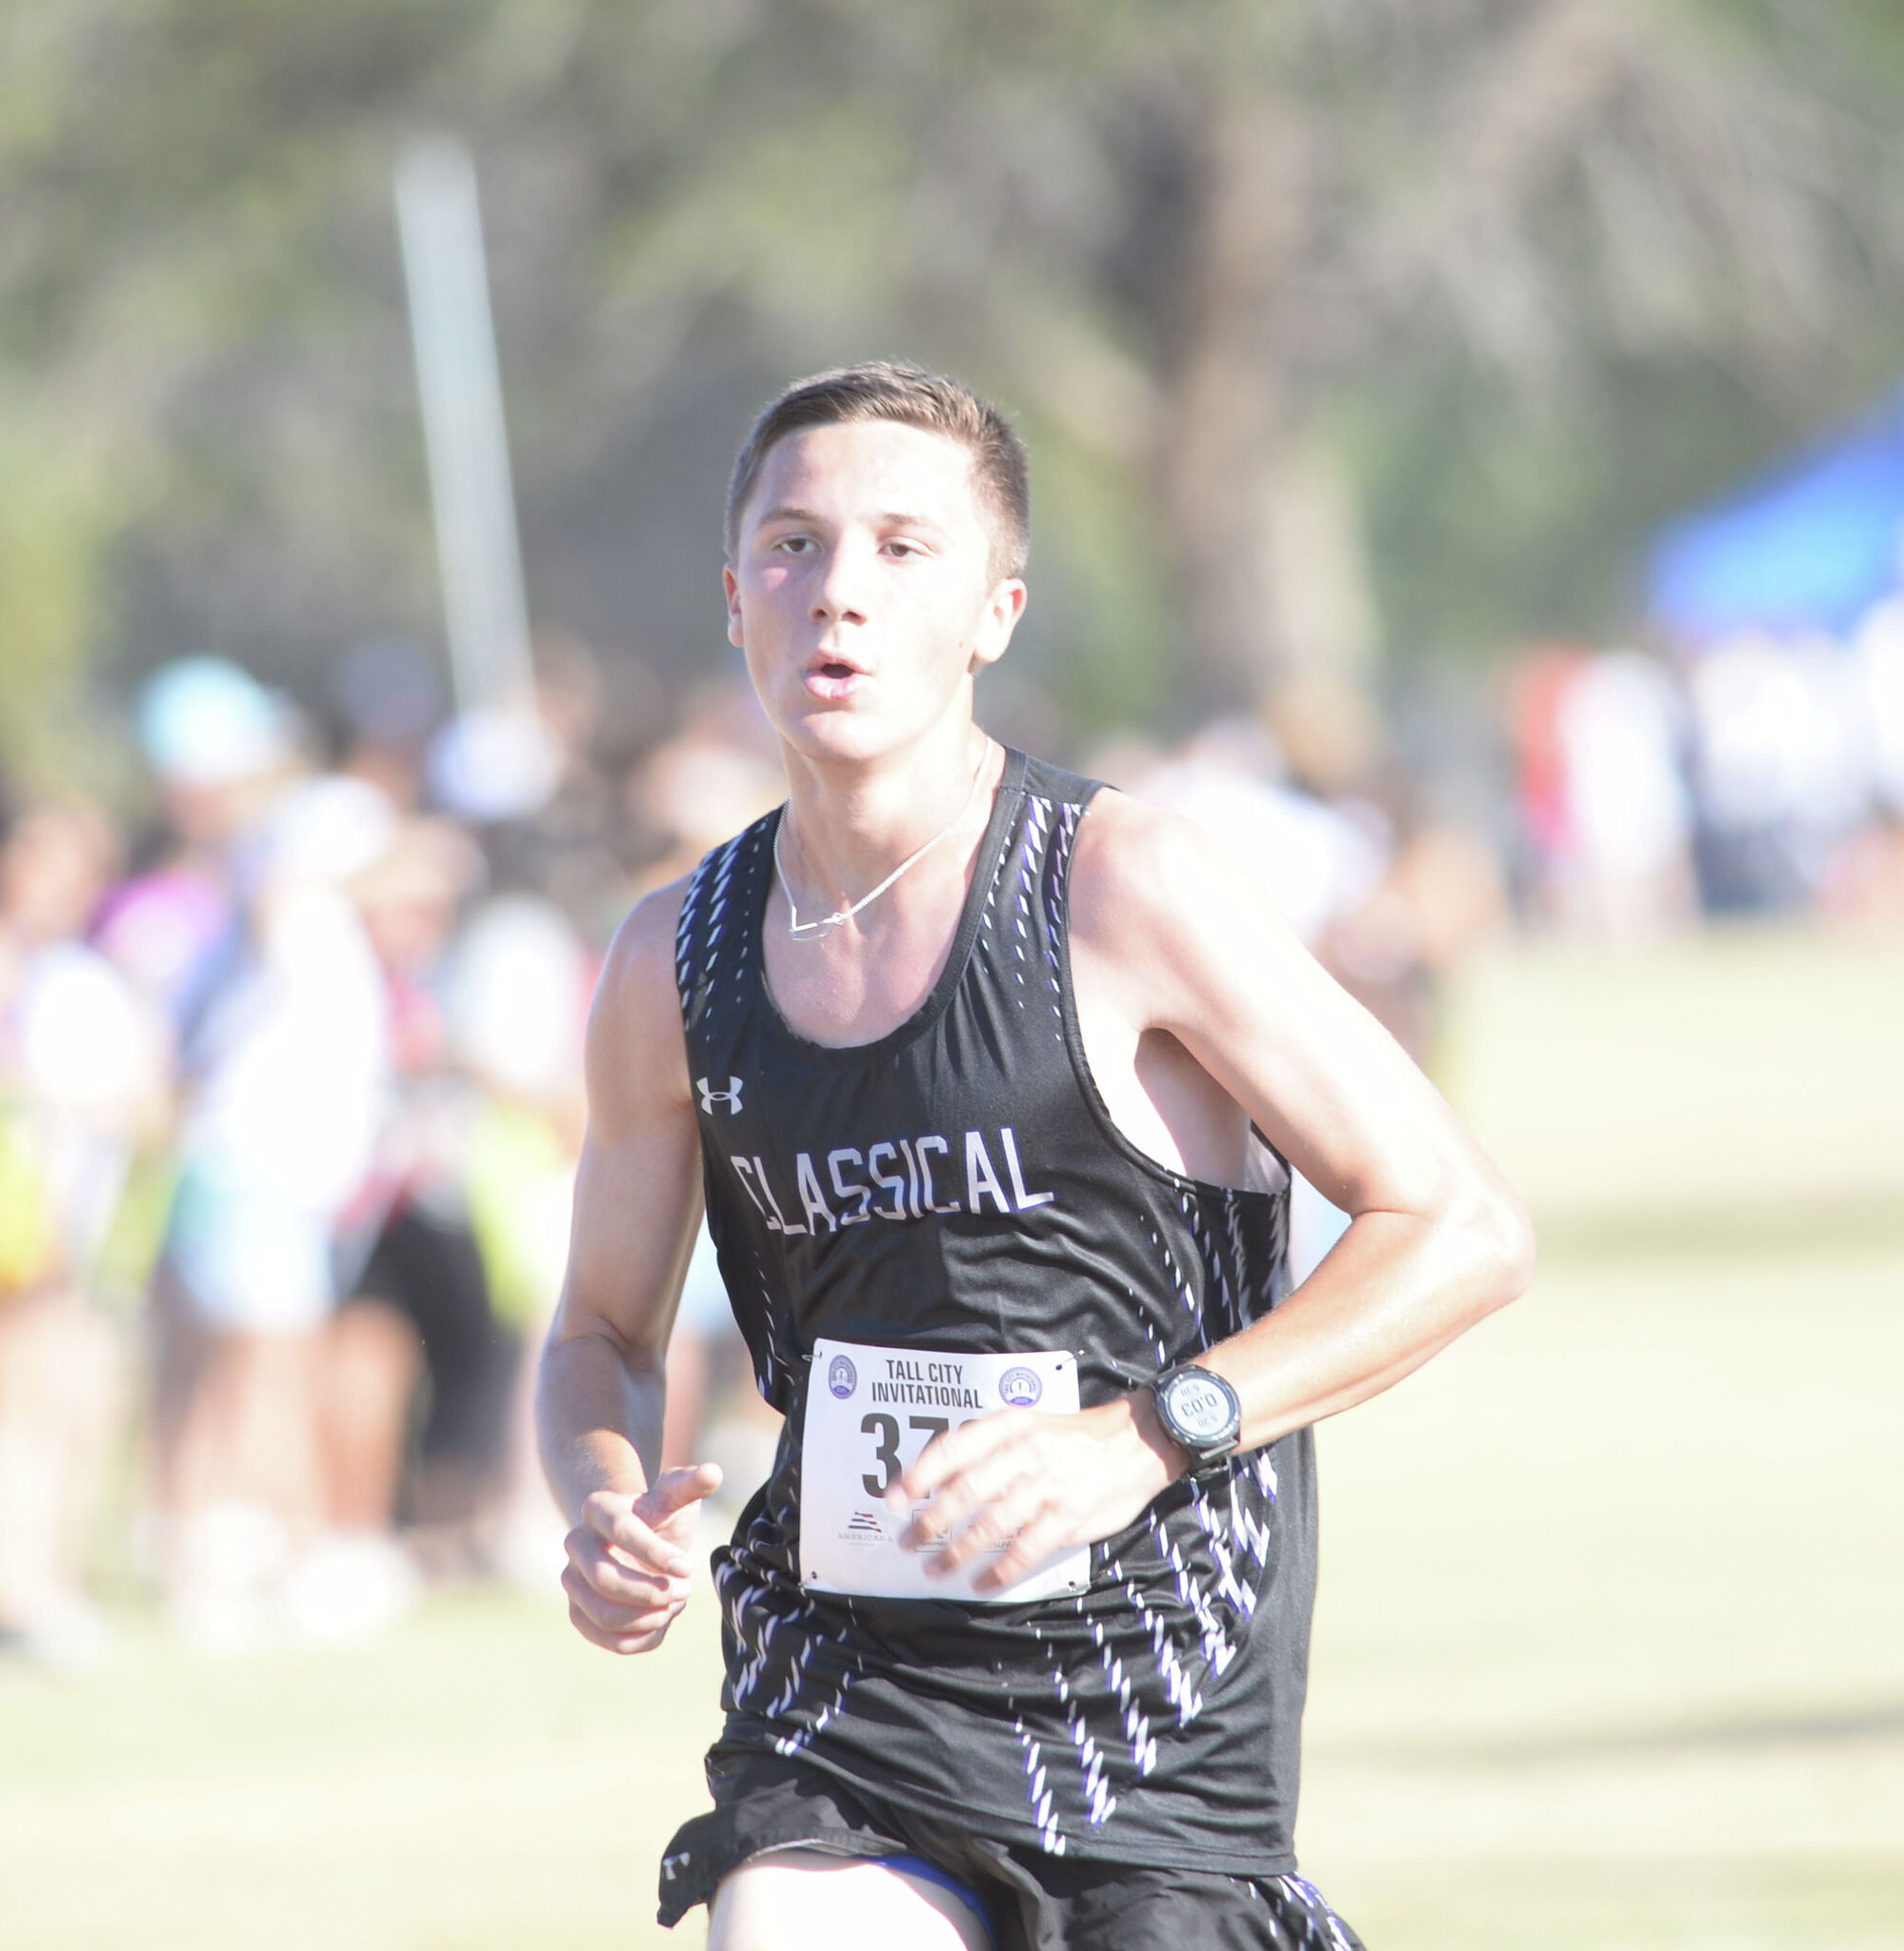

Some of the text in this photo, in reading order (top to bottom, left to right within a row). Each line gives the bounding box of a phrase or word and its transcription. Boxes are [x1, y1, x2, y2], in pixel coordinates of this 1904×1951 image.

[730, 1126, 1054, 1237] CLASSICAL
[885, 1358, 963, 1384] TALL CITY
[872, 1381, 984, 1410] INVITATIONAL
[860, 1412, 983, 1499] 37
[837, 1531, 893, 1542] AMERICANA
